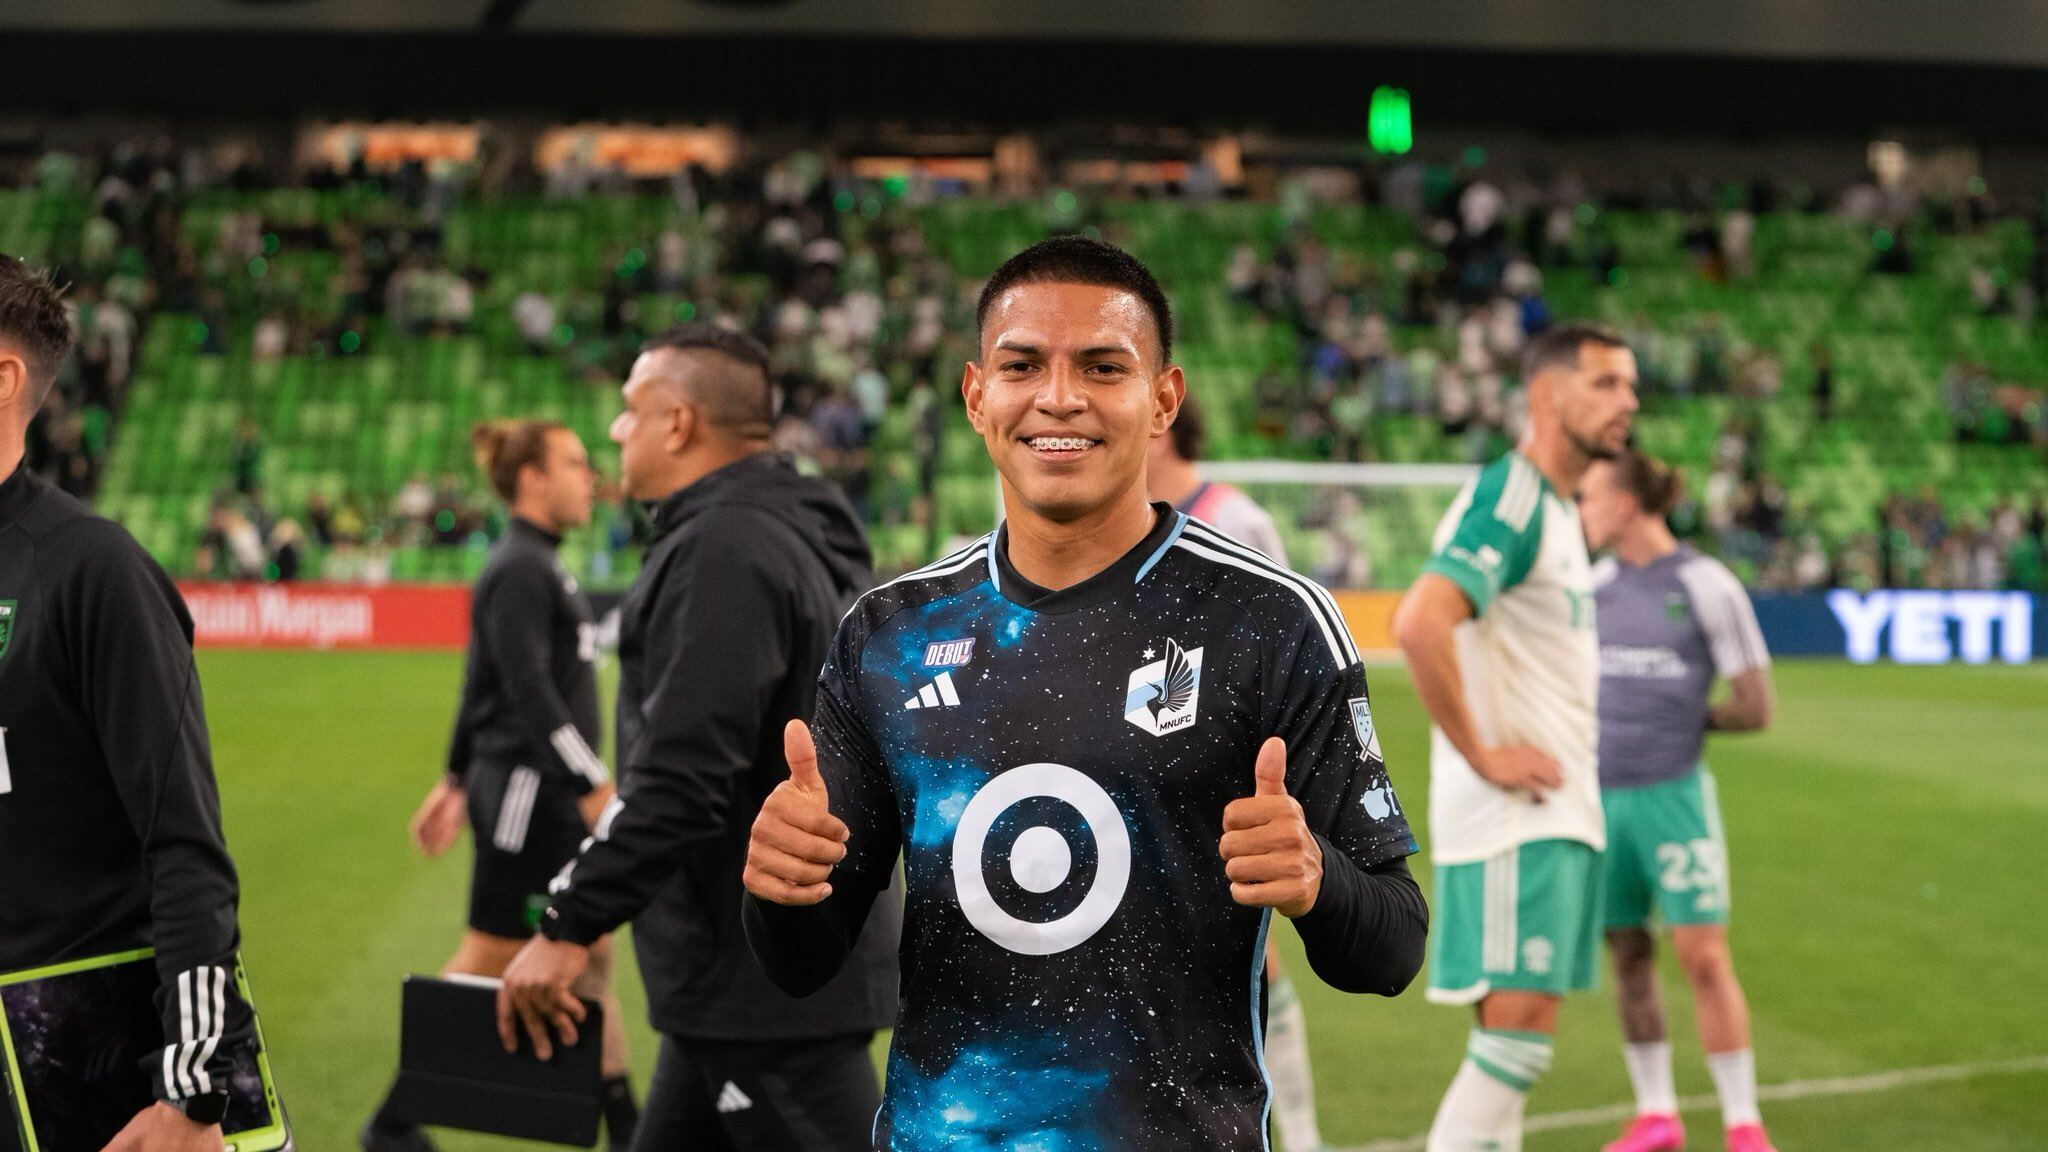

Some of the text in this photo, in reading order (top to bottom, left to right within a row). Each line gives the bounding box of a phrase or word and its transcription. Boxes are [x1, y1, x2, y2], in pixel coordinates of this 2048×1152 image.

[1826, 589, 2031, 664] YETI
[925, 641, 973, 665] DEBUT
[1160, 715, 1192, 732] MNUFC
